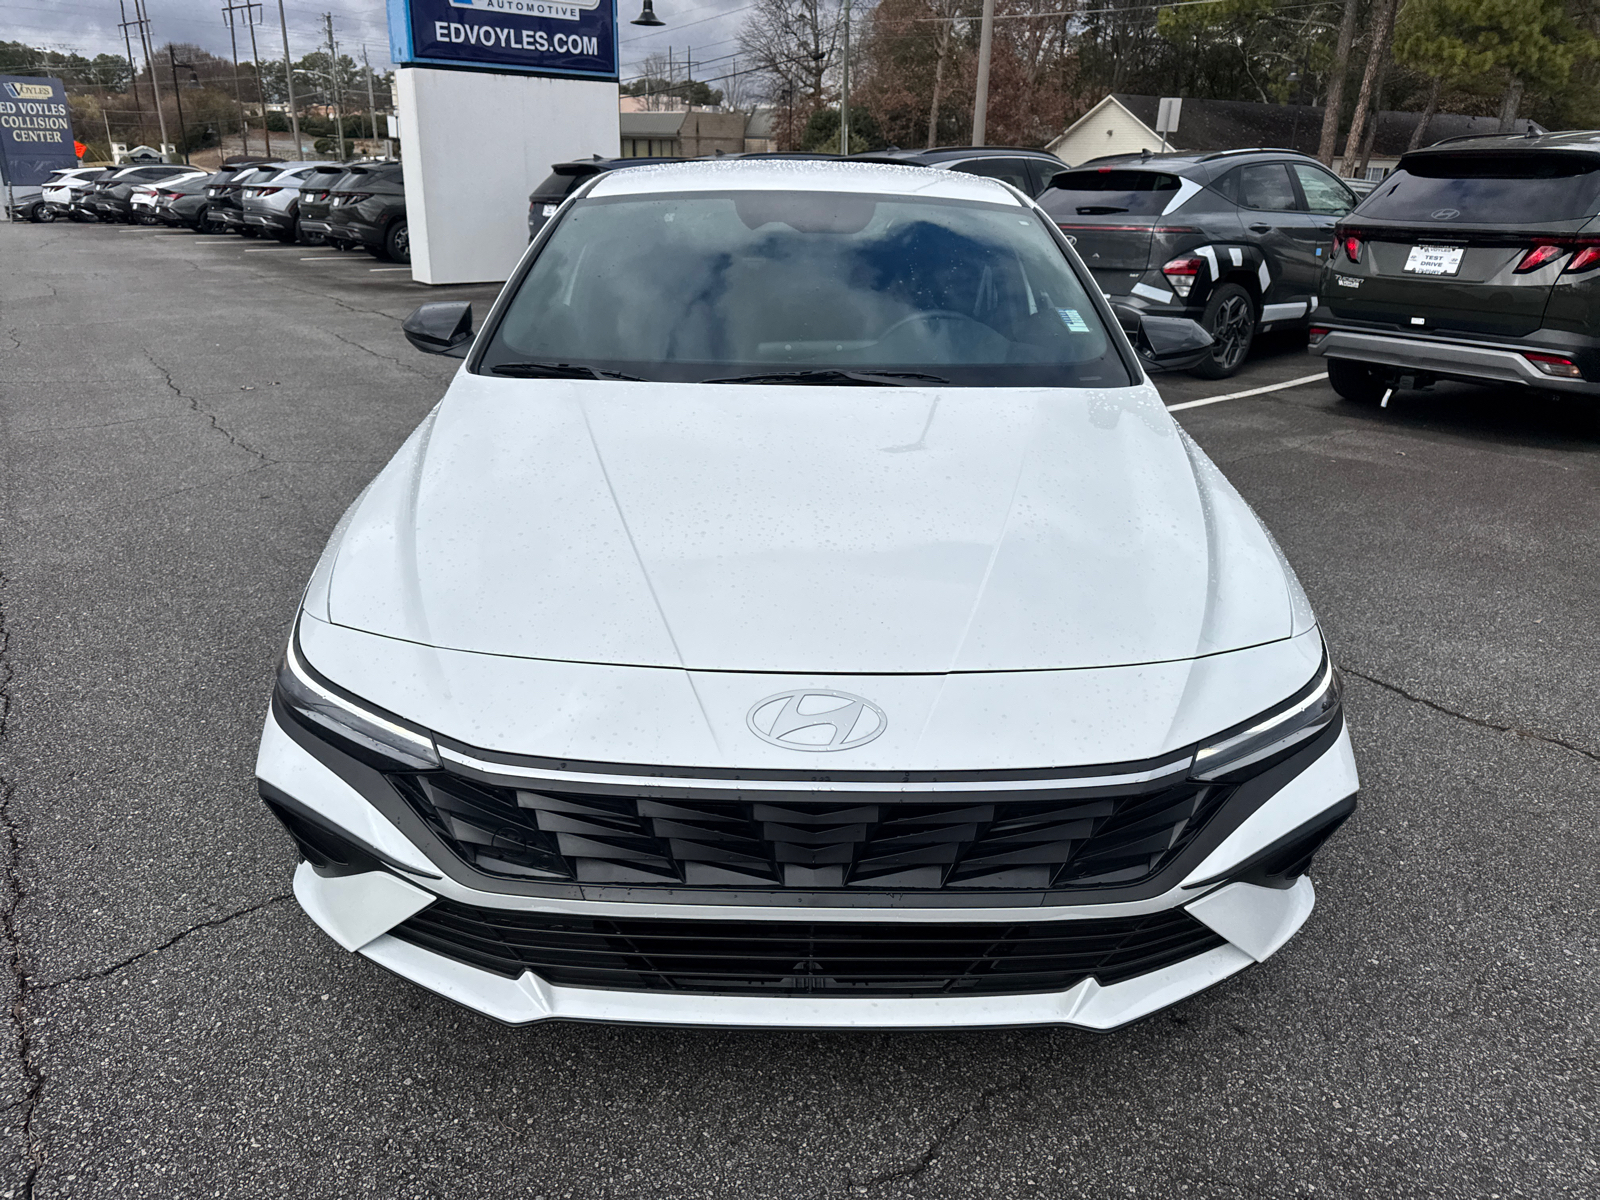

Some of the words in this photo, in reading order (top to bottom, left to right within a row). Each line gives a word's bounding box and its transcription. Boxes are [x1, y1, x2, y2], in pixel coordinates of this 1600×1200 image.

[487, 0, 577, 17] AUTOMOTIVE
[434, 21, 598, 56] EDVOYLES.COM
[10, 82, 50, 96] VOYLES
[0, 101, 16, 114] ED
[17, 102, 67, 116] VOYLES
[1, 115, 68, 130] COLLISION
[12, 129, 63, 143] CENTER
